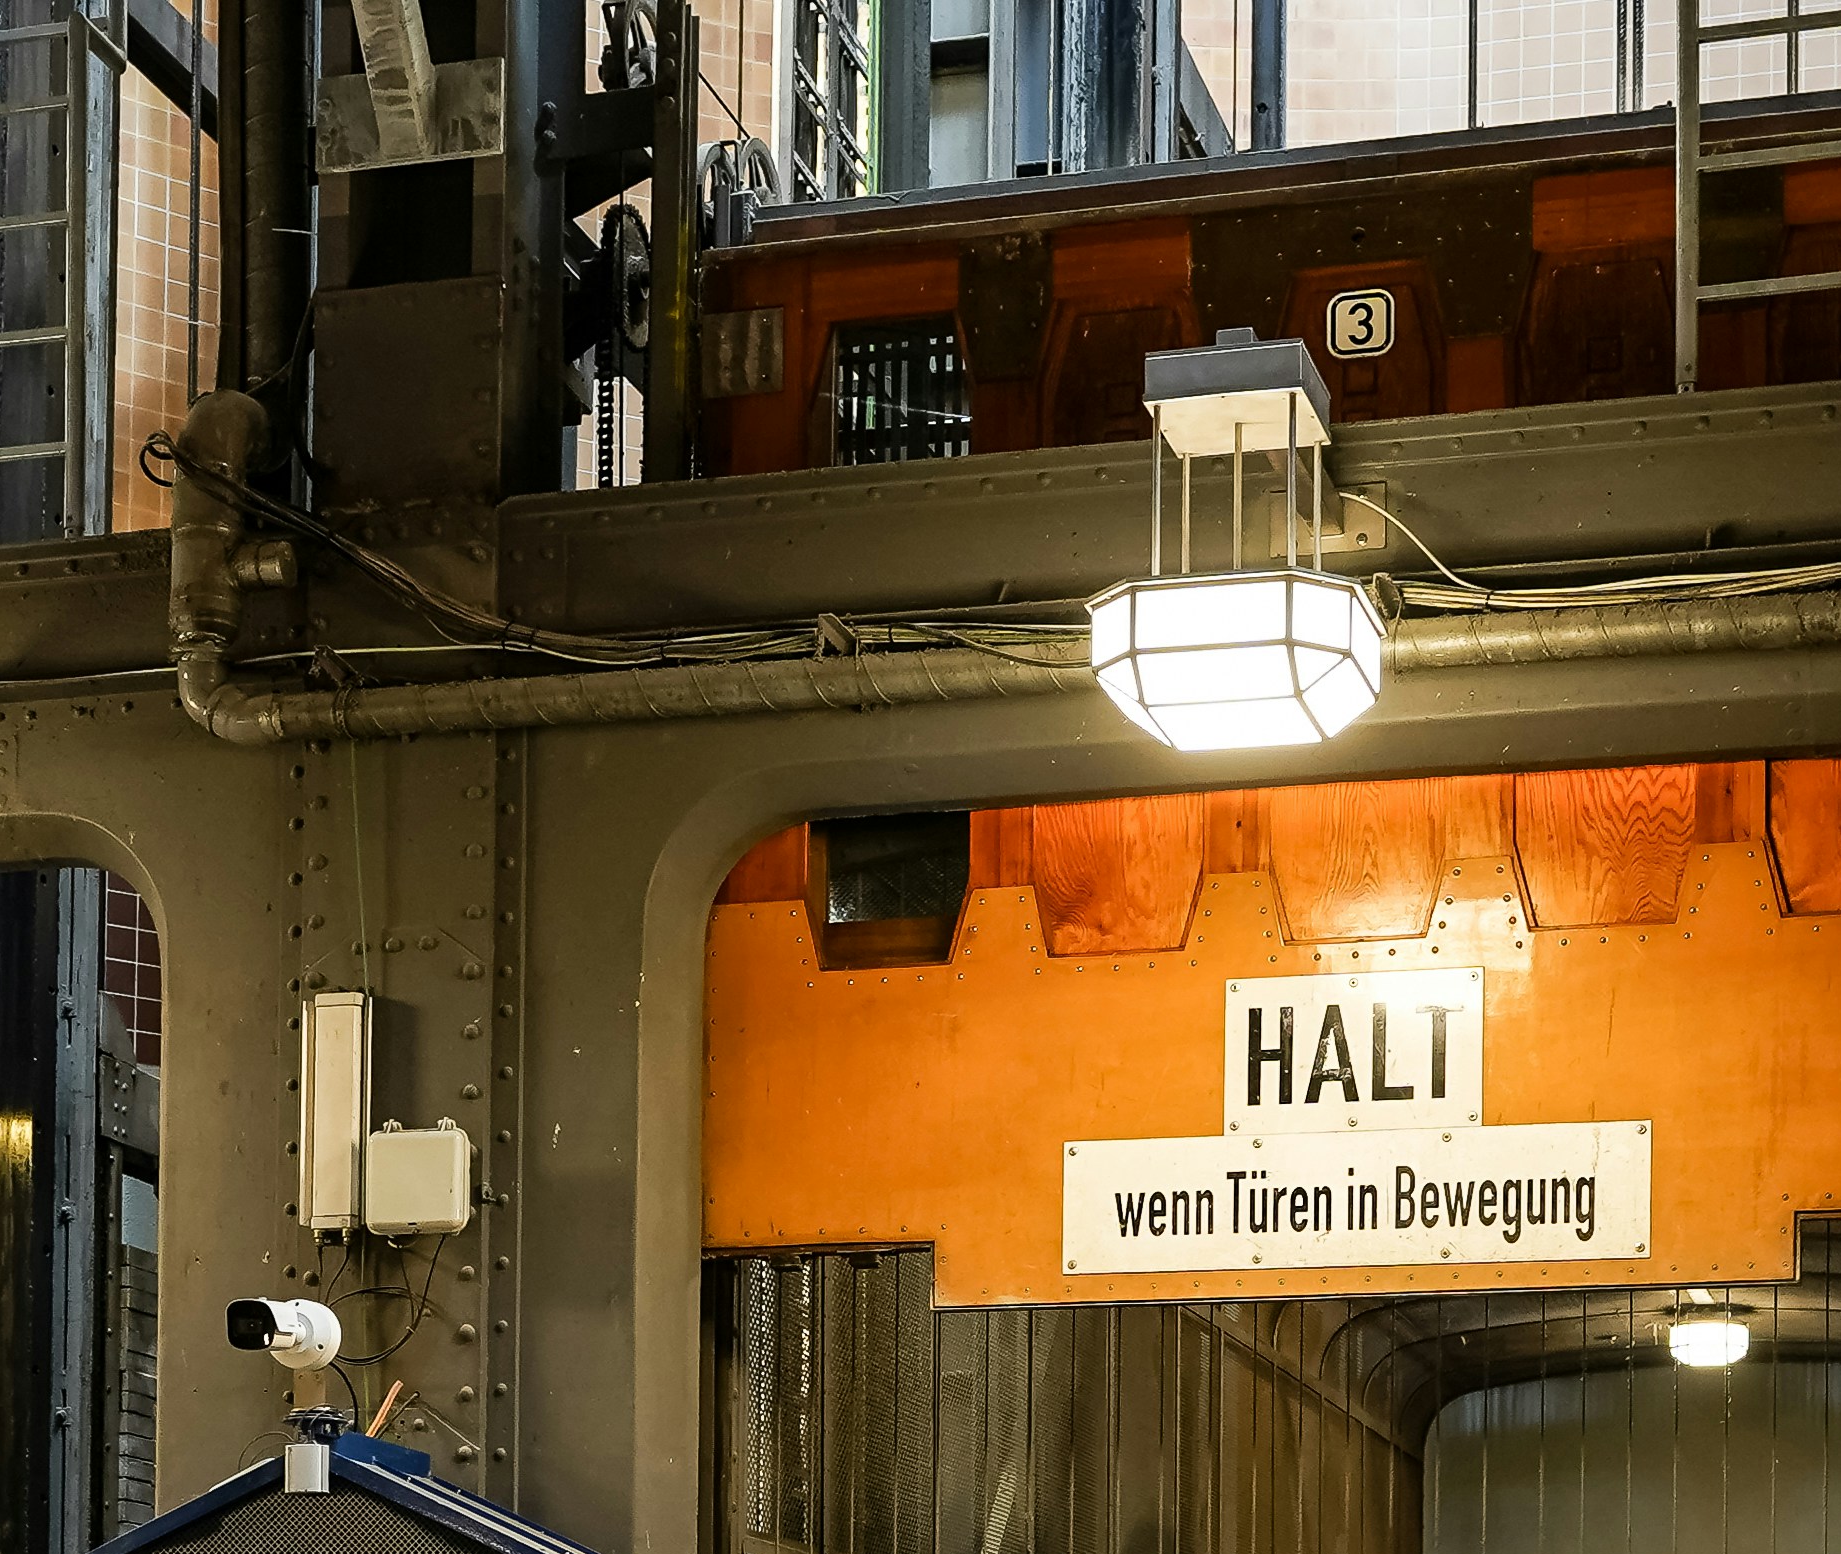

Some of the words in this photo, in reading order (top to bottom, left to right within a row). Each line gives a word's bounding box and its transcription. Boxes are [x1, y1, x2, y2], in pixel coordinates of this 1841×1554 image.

[1348, 302, 1374, 346] 3
[1247, 1003, 1464, 1107] HALT
[1115, 1189, 1214, 1238] wenn
[1227, 1170, 1333, 1234] Türen
[1347, 1167, 1379, 1231] in
[1394, 1165, 1597, 1244] Bewegung
